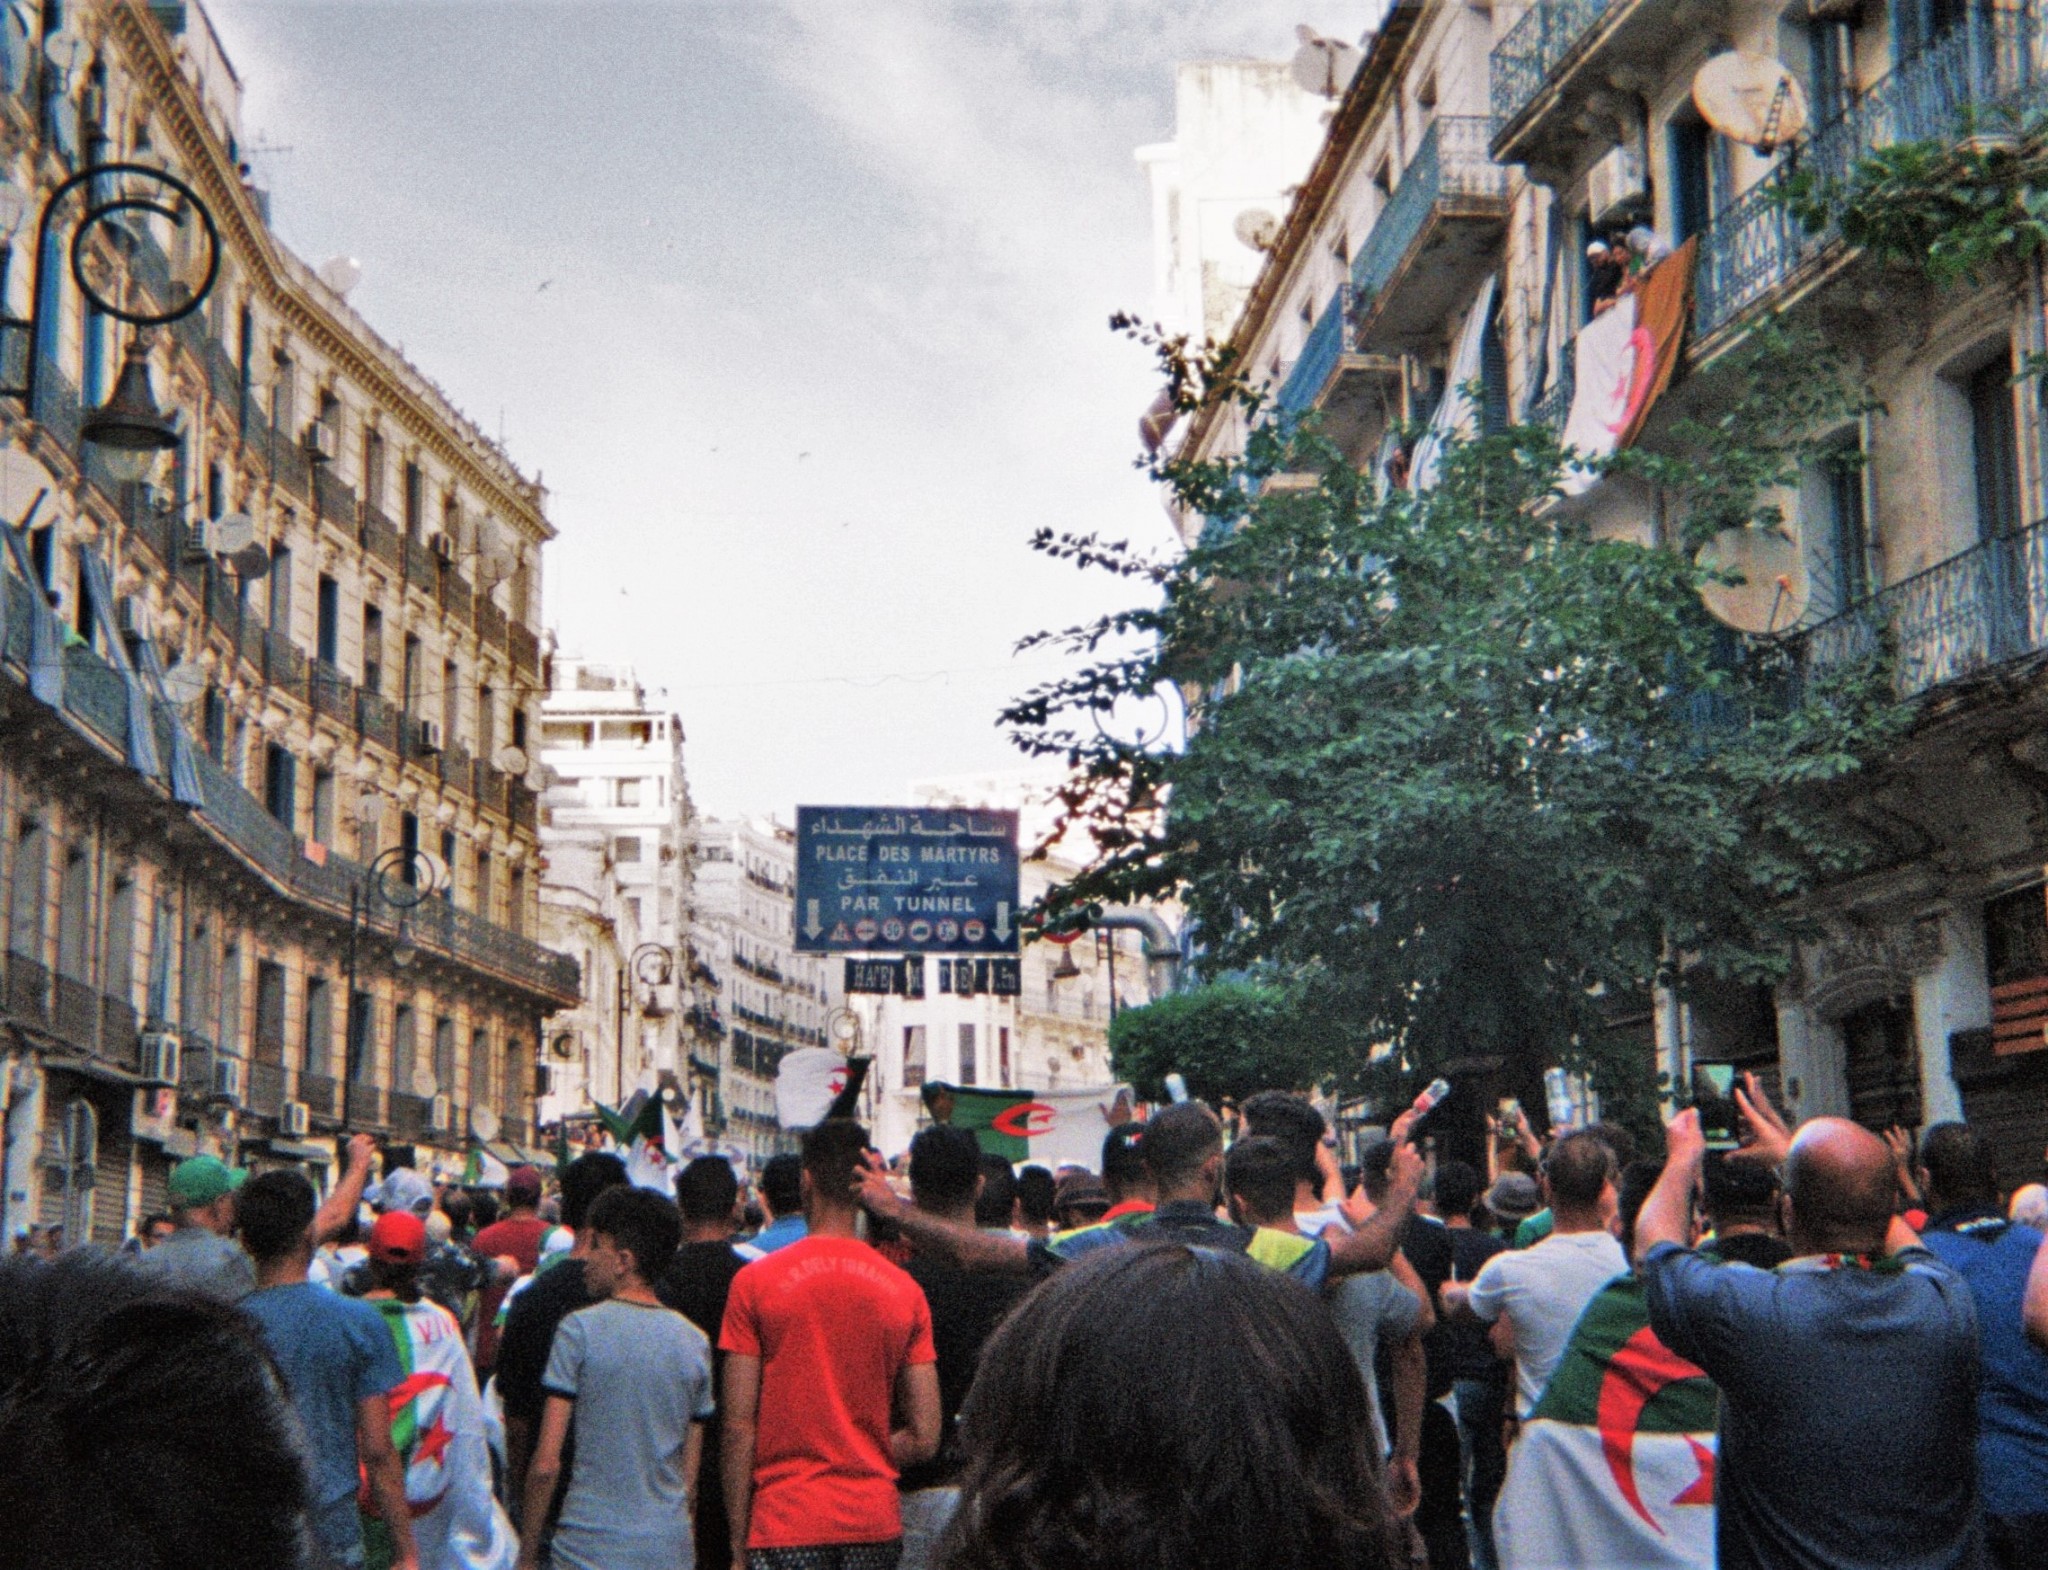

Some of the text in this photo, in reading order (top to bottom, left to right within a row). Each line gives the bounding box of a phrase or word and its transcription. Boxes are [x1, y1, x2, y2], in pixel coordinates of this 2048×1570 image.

[811, 813, 1006, 840] ساحة الشهداء
[815, 845, 1000, 864] PLACE DES MARTYRS
[837, 867, 978, 892] عبر النفق
[841, 895, 976, 912] PAR TUNNEL
